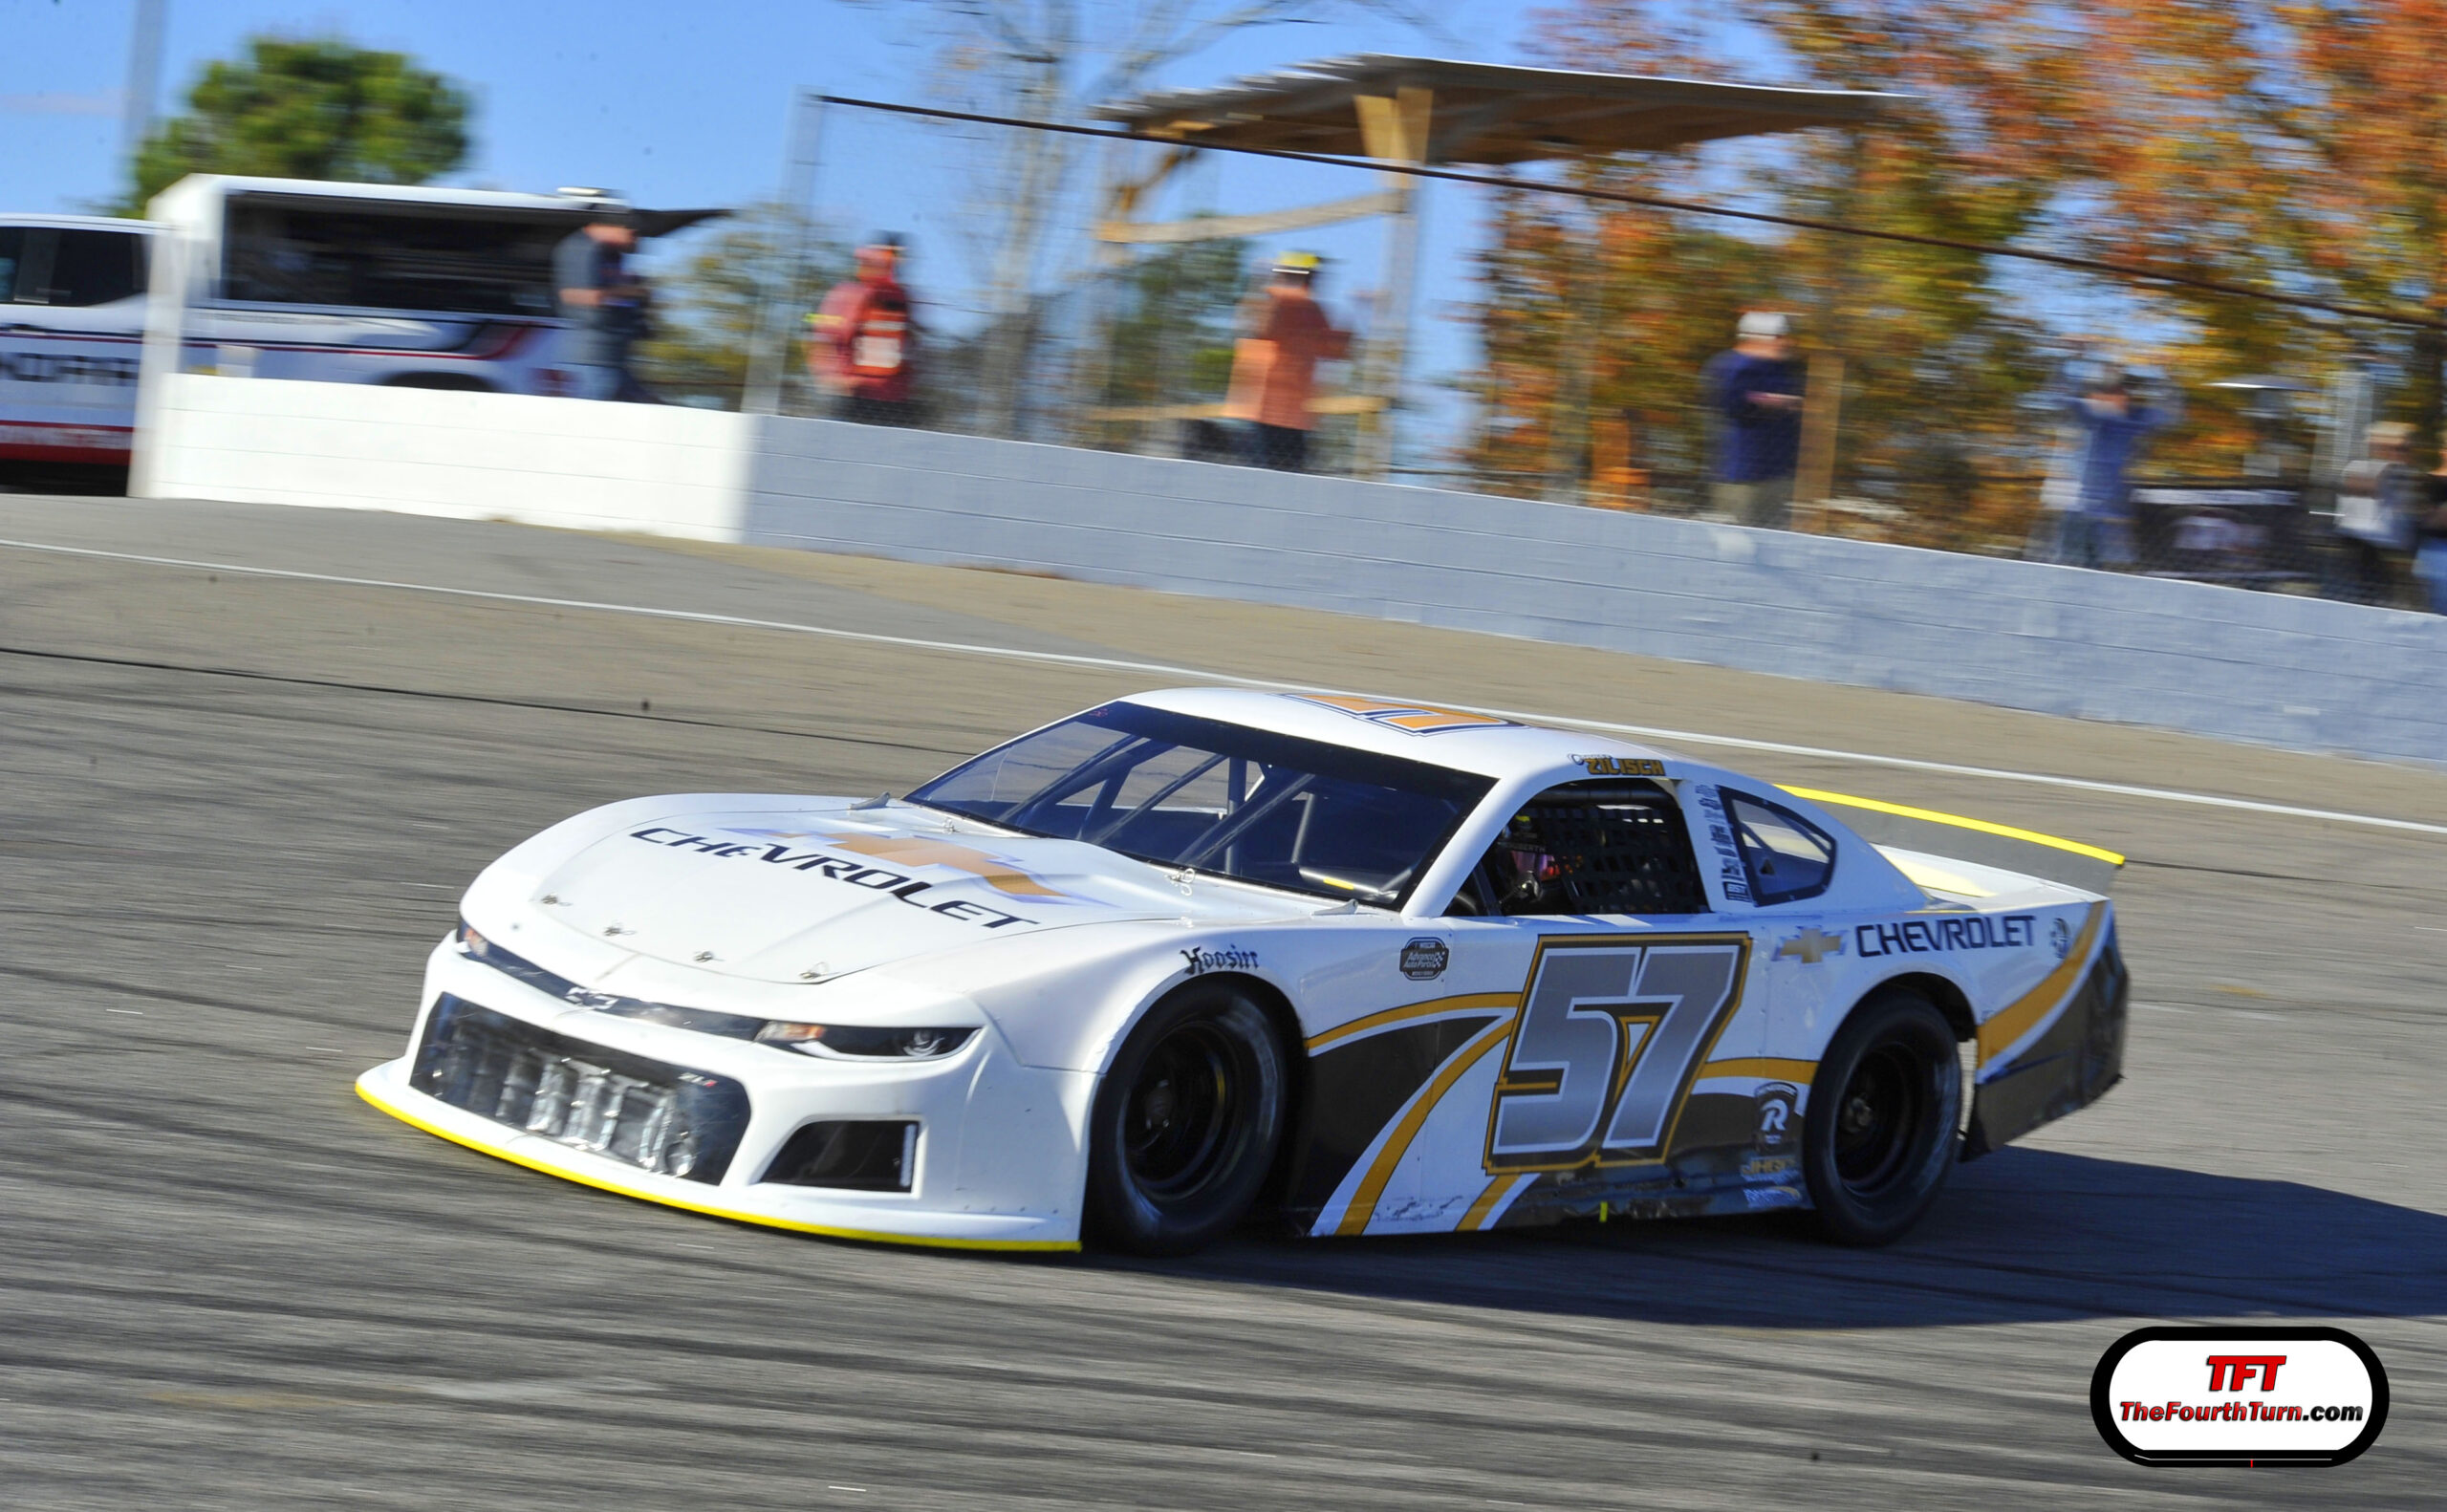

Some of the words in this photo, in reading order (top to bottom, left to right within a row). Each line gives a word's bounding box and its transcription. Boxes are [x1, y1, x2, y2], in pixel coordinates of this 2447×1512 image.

[629, 828, 1040, 929] CHEVROLET
[1855, 915, 2036, 958] CHEVROLET
[1483, 934, 1751, 1172] 57
